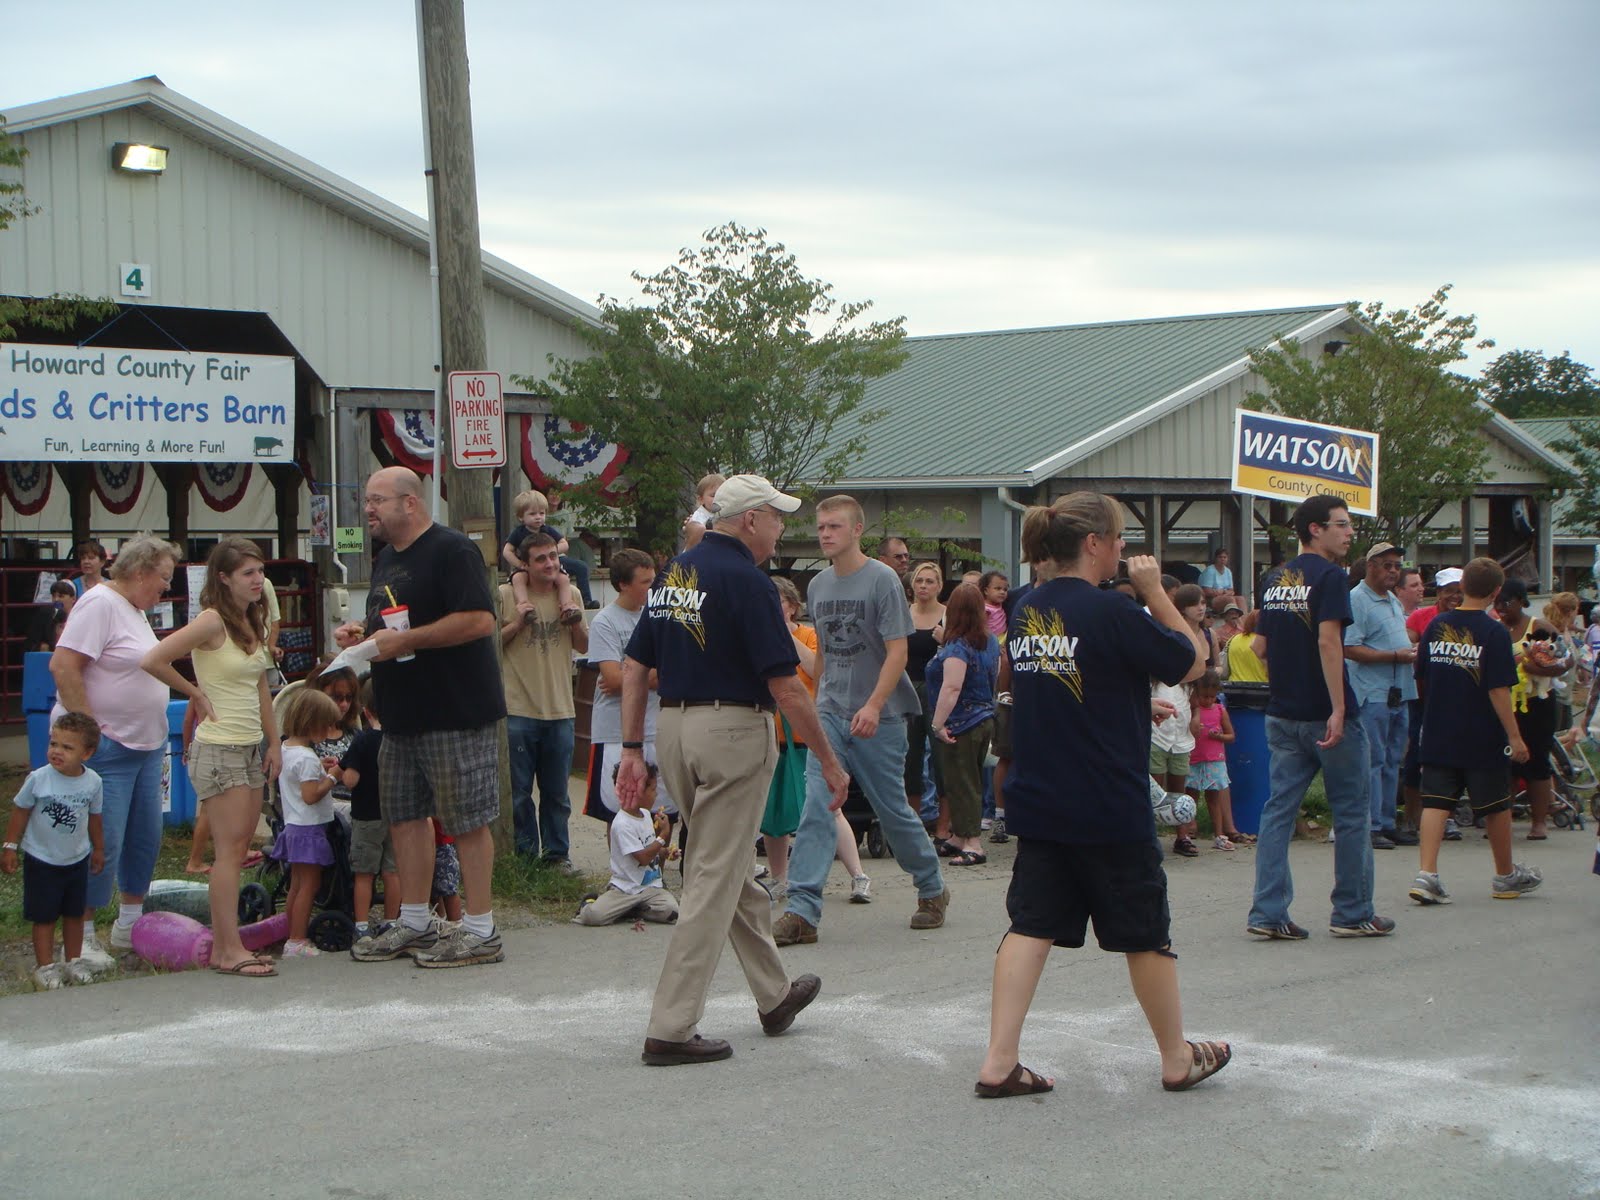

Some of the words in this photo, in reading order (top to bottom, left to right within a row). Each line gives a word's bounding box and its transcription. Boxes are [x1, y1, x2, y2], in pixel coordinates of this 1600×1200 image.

[126, 268, 144, 291] 4
[11, 350, 105, 376] Howard
[117, 354, 196, 386] County
[206, 358, 251, 381] Fair
[466, 380, 486, 398] NO
[52, 390, 74, 420] &
[88, 392, 210, 423] Critters
[223, 395, 287, 425] Barn
[455, 399, 499, 418] PARKING
[466, 420, 490, 431] FIRE
[44, 438, 74, 454] Fun,
[81, 438, 140, 456] Learning
[146, 440, 156, 453] &
[161, 440, 194, 453] More
[199, 440, 226, 454] Fun!
[464, 433, 493, 446] LANE
[1244, 428, 1361, 476] WATSON
[1268, 476, 1313, 495] County
[1315, 483, 1360, 503] Council
[345, 528, 355, 536] NO
[337, 541, 363, 550] Smoking
[1040, 658, 1077, 671] Council
[1430, 656, 1454, 666] ounty
